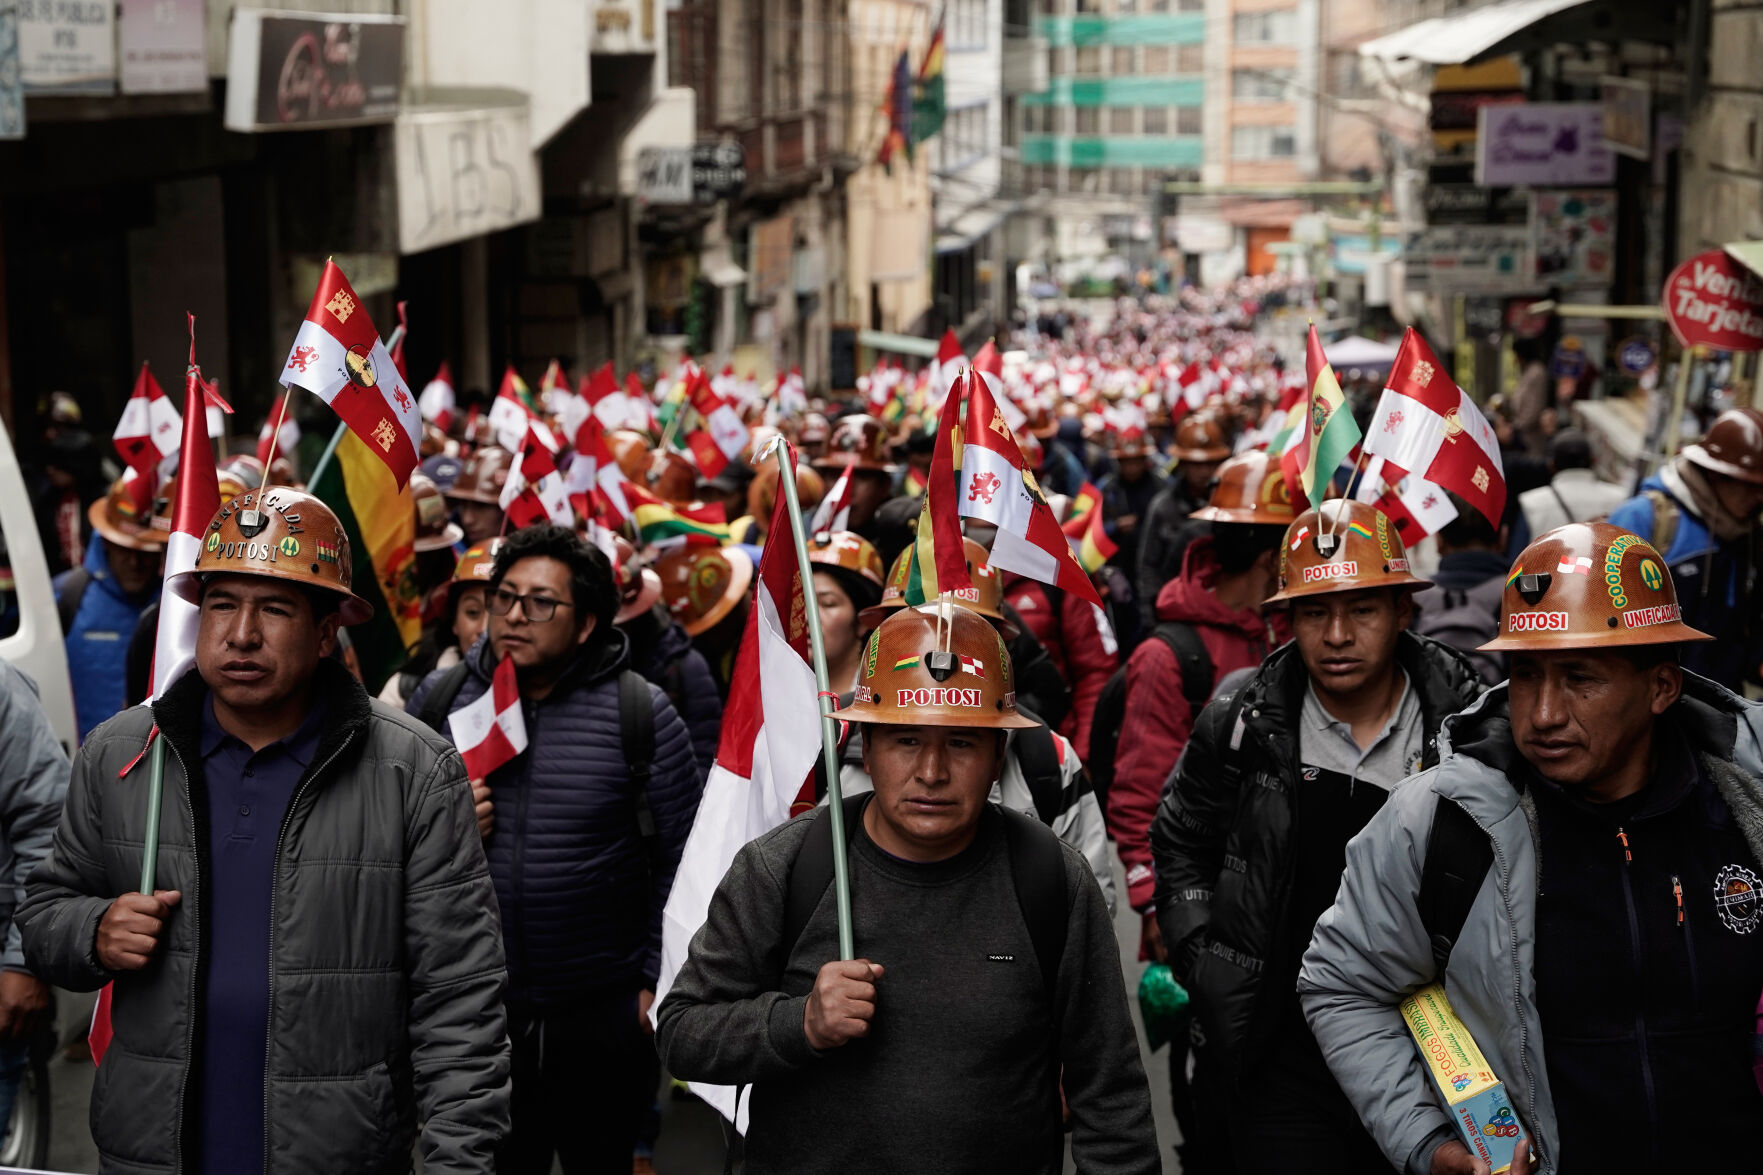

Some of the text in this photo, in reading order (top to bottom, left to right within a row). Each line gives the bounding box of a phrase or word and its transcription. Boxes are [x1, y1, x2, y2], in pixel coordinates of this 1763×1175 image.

[216, 542, 279, 562] POTOSI
[1304, 562, 1356, 581] POTOSI
[1509, 614, 1567, 630] POTOSI
[898, 689, 981, 706] POTOSI
[1427, 1037, 1456, 1077] FOGOS
[1462, 1113, 1478, 1137] TIROS
